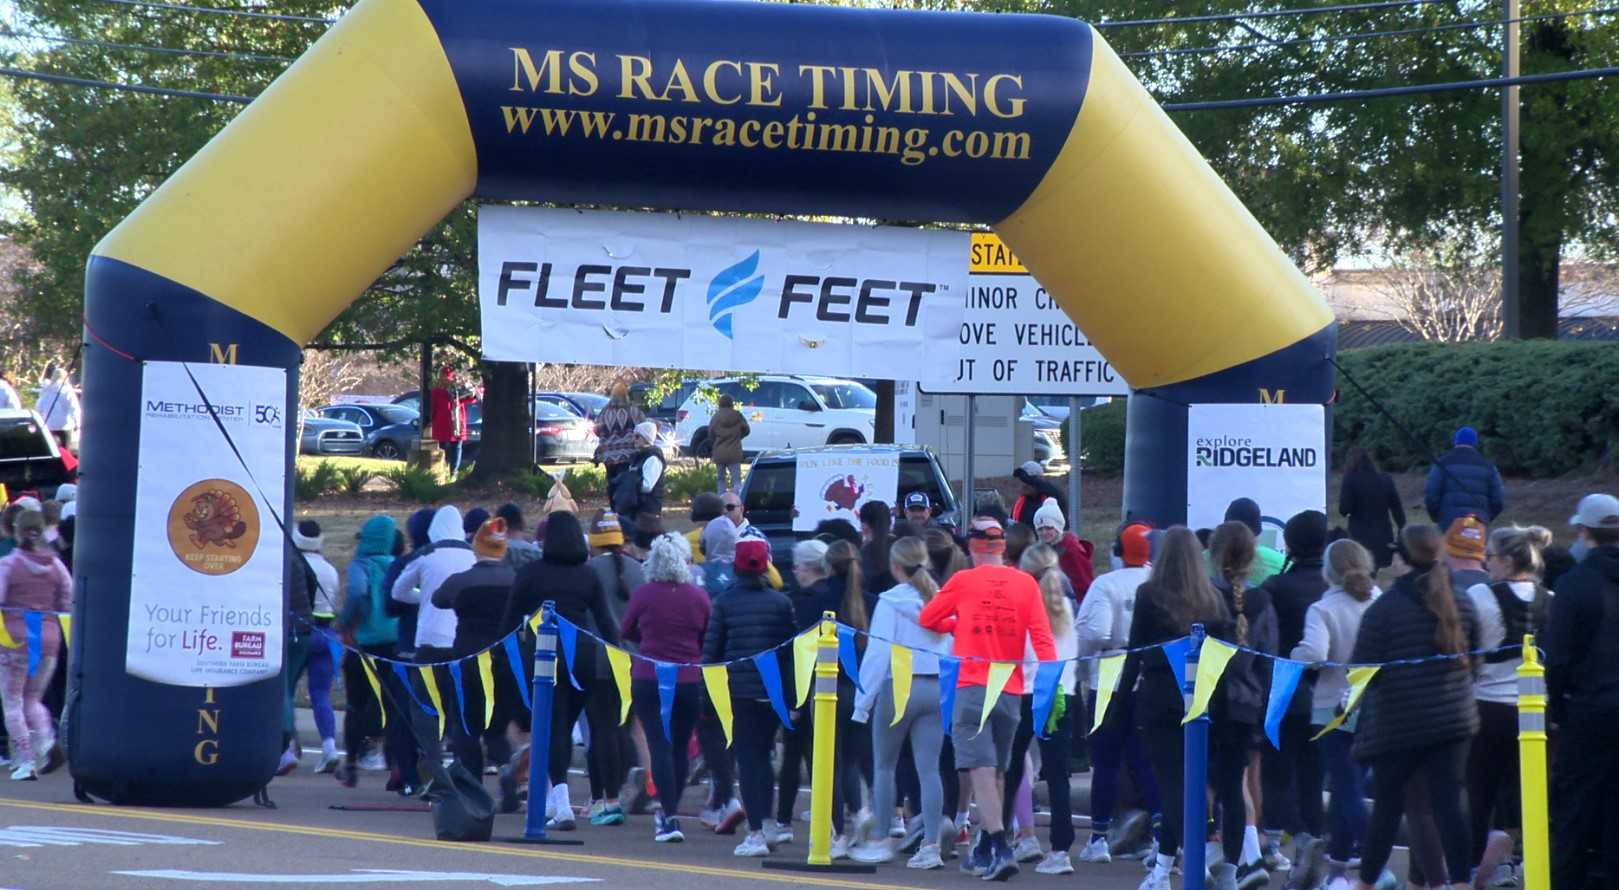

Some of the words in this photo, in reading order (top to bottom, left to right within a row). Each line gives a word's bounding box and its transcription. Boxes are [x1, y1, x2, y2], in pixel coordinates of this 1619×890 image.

[508, 47, 599, 97] MS
[616, 54, 783, 107] RACE
[799, 65, 1028, 119] TIMING
[500, 105, 1032, 166] www.msracetiming.com
[971, 243, 1022, 266] STA
[497, 261, 691, 313] FLEET
[778, 274, 937, 327] FEET
[965, 287, 1018, 310] INOR
[960, 323, 997, 345] OVE
[1014, 323, 1092, 346] VEHICL
[993, 359, 1018, 382] OF
[1035, 359, 1115, 383] TRAFFIC
[1196, 434, 1252, 449] explore
[145, 604, 192, 623] Your
[200, 605, 272, 626] Friends
[146, 626, 176, 653] for
[182, 628, 223, 655] Life.
